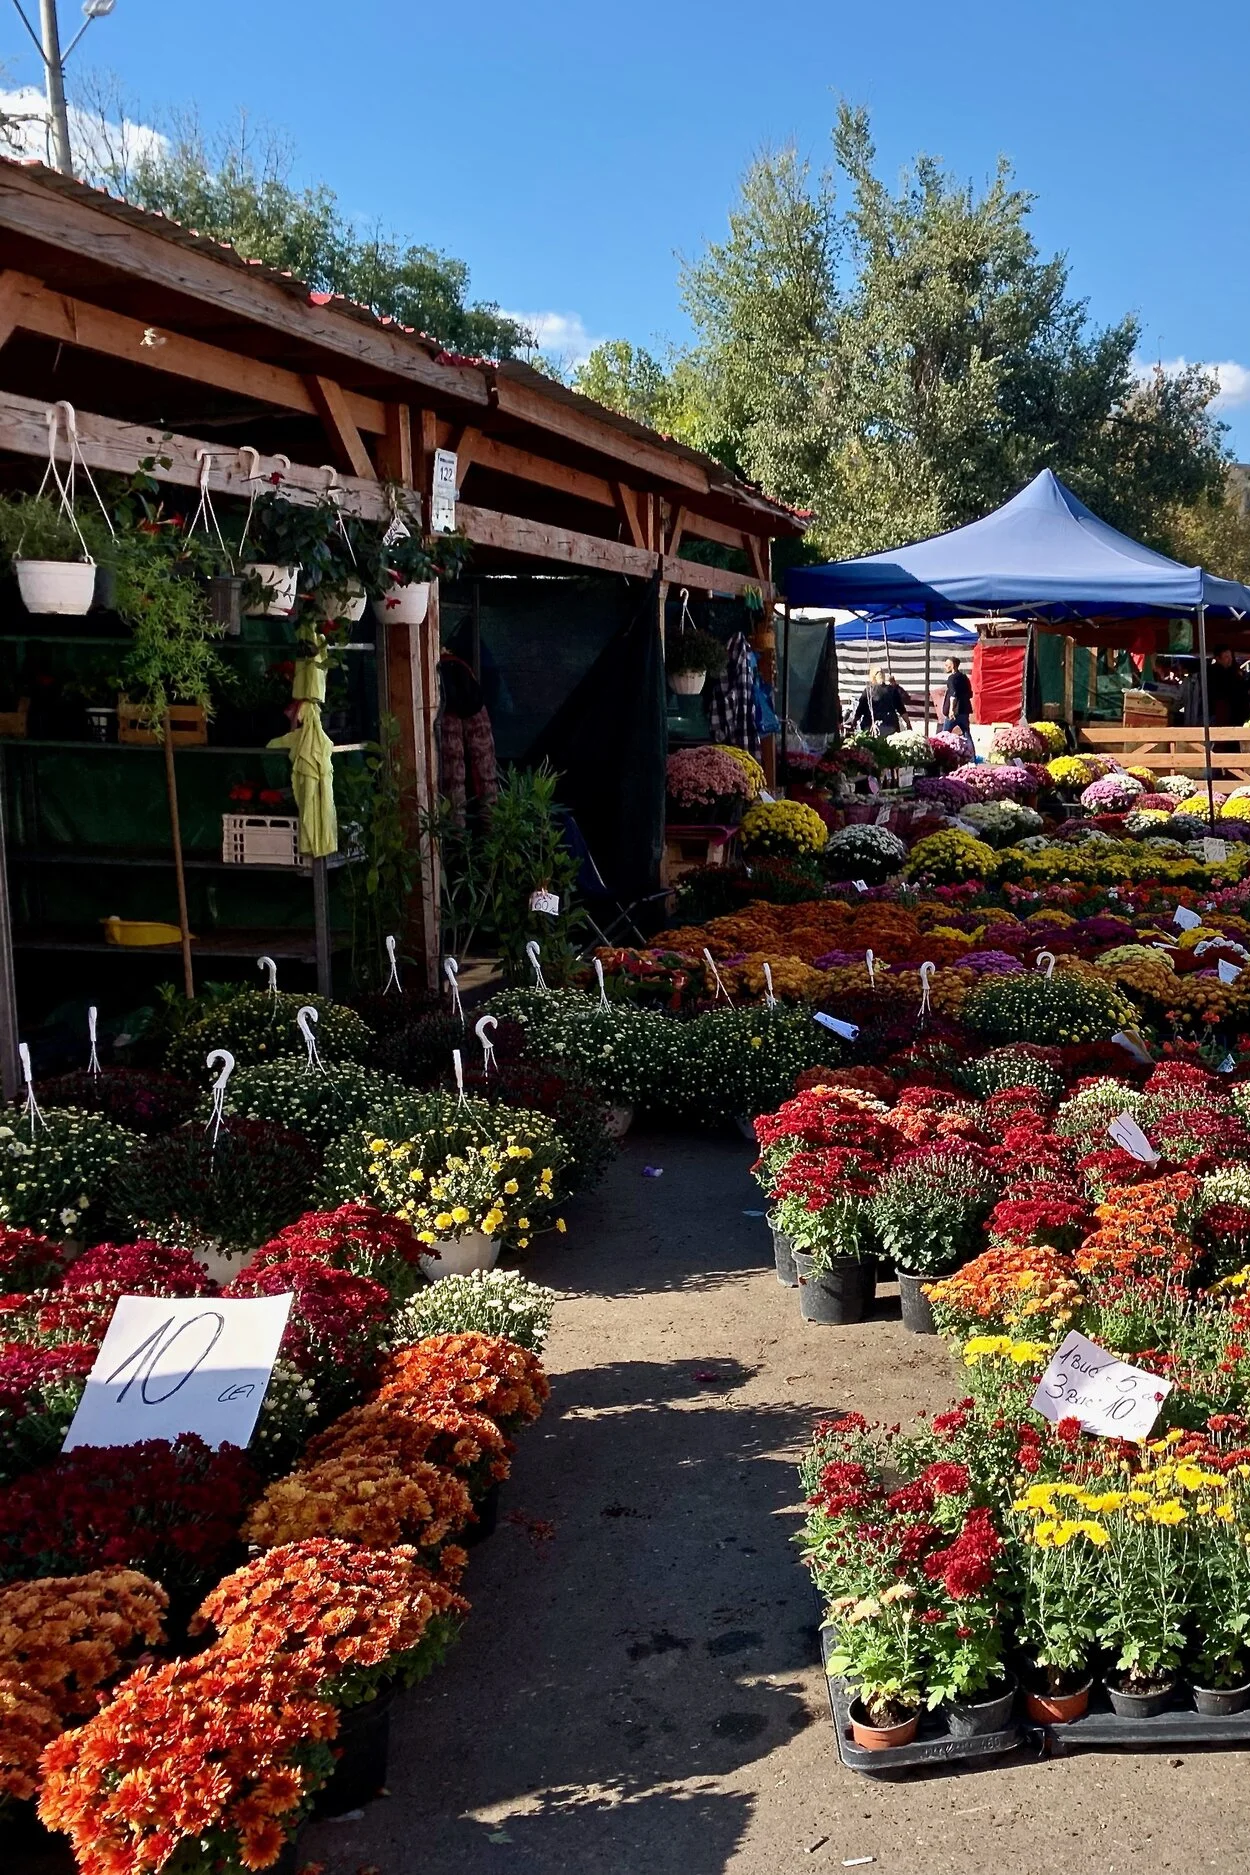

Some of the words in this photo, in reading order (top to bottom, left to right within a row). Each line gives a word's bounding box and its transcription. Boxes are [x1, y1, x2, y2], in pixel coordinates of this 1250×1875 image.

[440, 467, 453, 482] 122
[105, 1311, 225, 1405] 10
[1045, 1373, 1068, 1399] 3
[1102, 1395, 1137, 1420] 10
